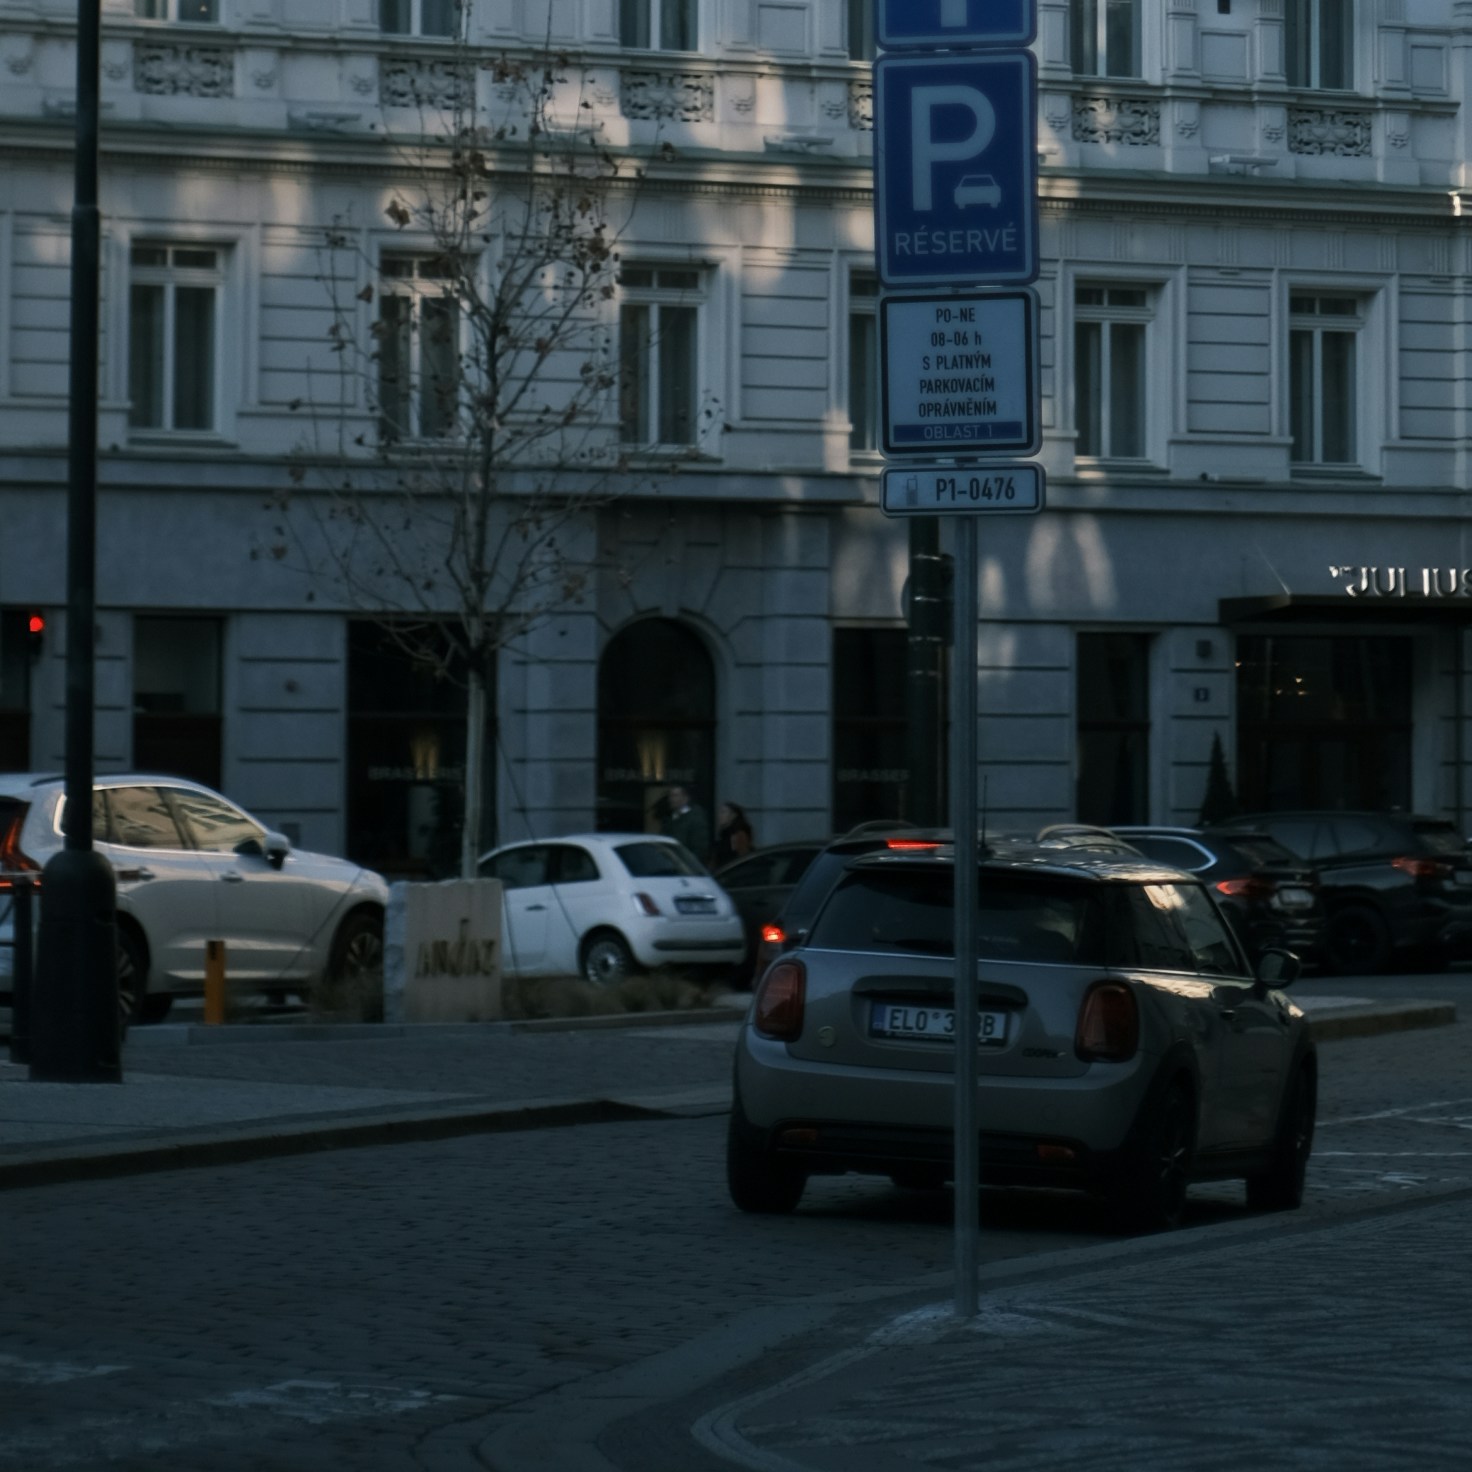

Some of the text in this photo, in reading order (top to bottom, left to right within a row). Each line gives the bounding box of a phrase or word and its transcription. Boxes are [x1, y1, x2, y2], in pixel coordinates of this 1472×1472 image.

[911, 85, 996, 211] P
[895, 222, 1017, 256] RÉSERVÉ
[936, 308, 975, 323] PO-NE
[931, 331, 982, 347] 08-06 h
[922, 351, 991, 370] S PLATNÝM
[919, 374, 995, 394] PARKOVACÍM
[918, 397, 997, 418] OPRÁVNĚNÍM
[923, 424, 993, 440] OBLAST 1
[936, 477, 1015, 501] P1-0476
